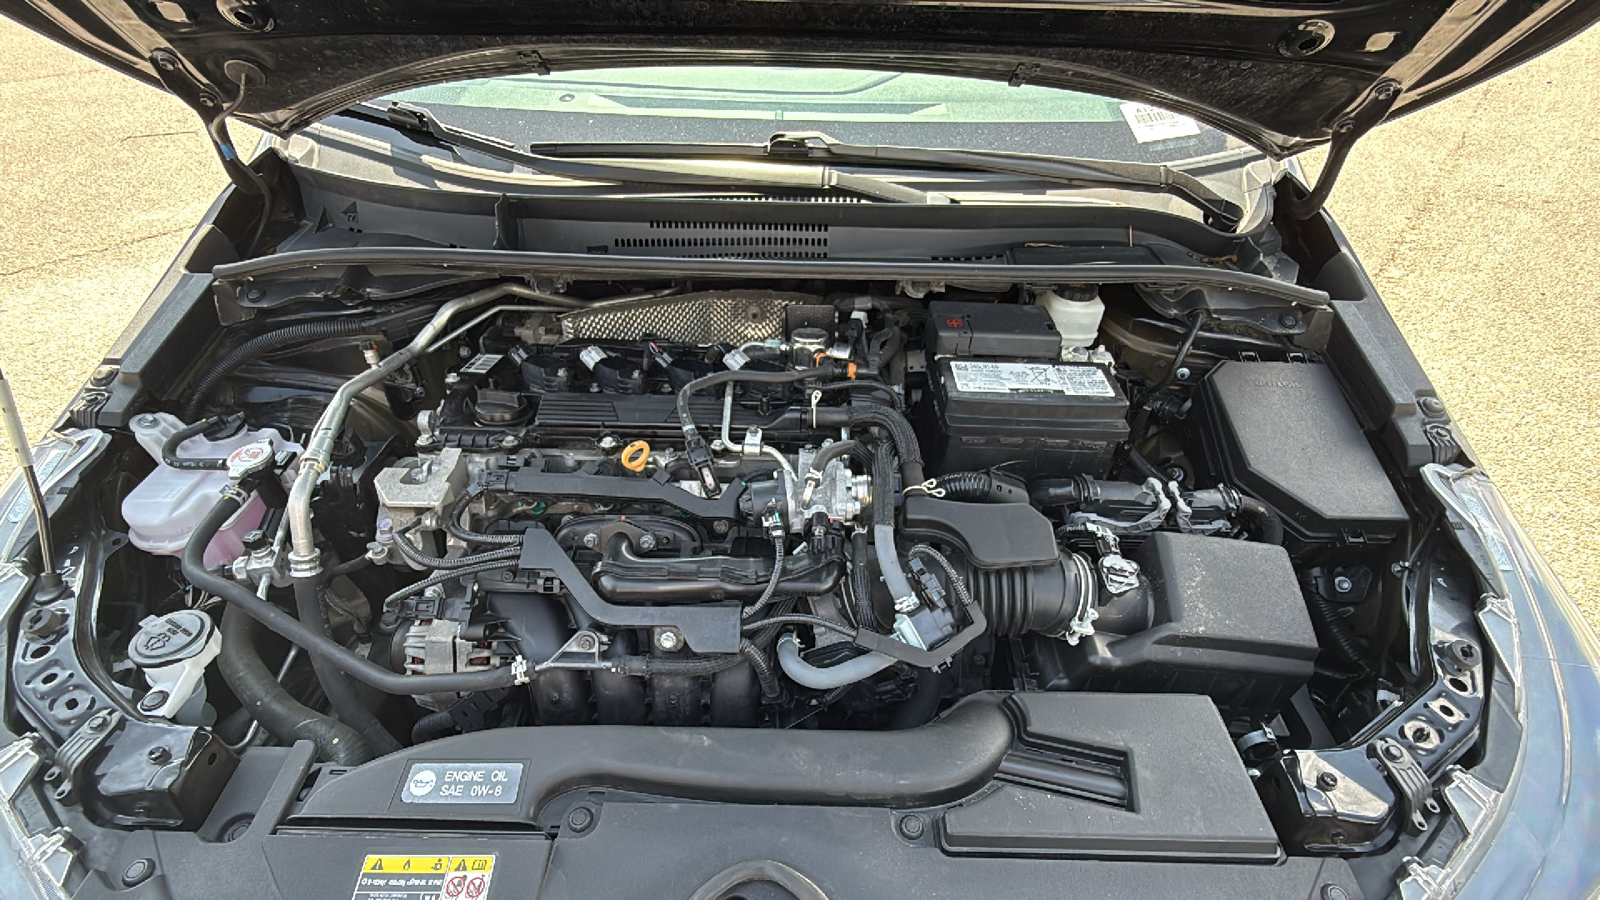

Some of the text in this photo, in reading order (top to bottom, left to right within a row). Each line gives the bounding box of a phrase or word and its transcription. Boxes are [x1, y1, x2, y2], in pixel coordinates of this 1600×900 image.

[444, 770, 509, 782] ENGINE OIL
[439, 784, 503, 797] SAE 0W-8
